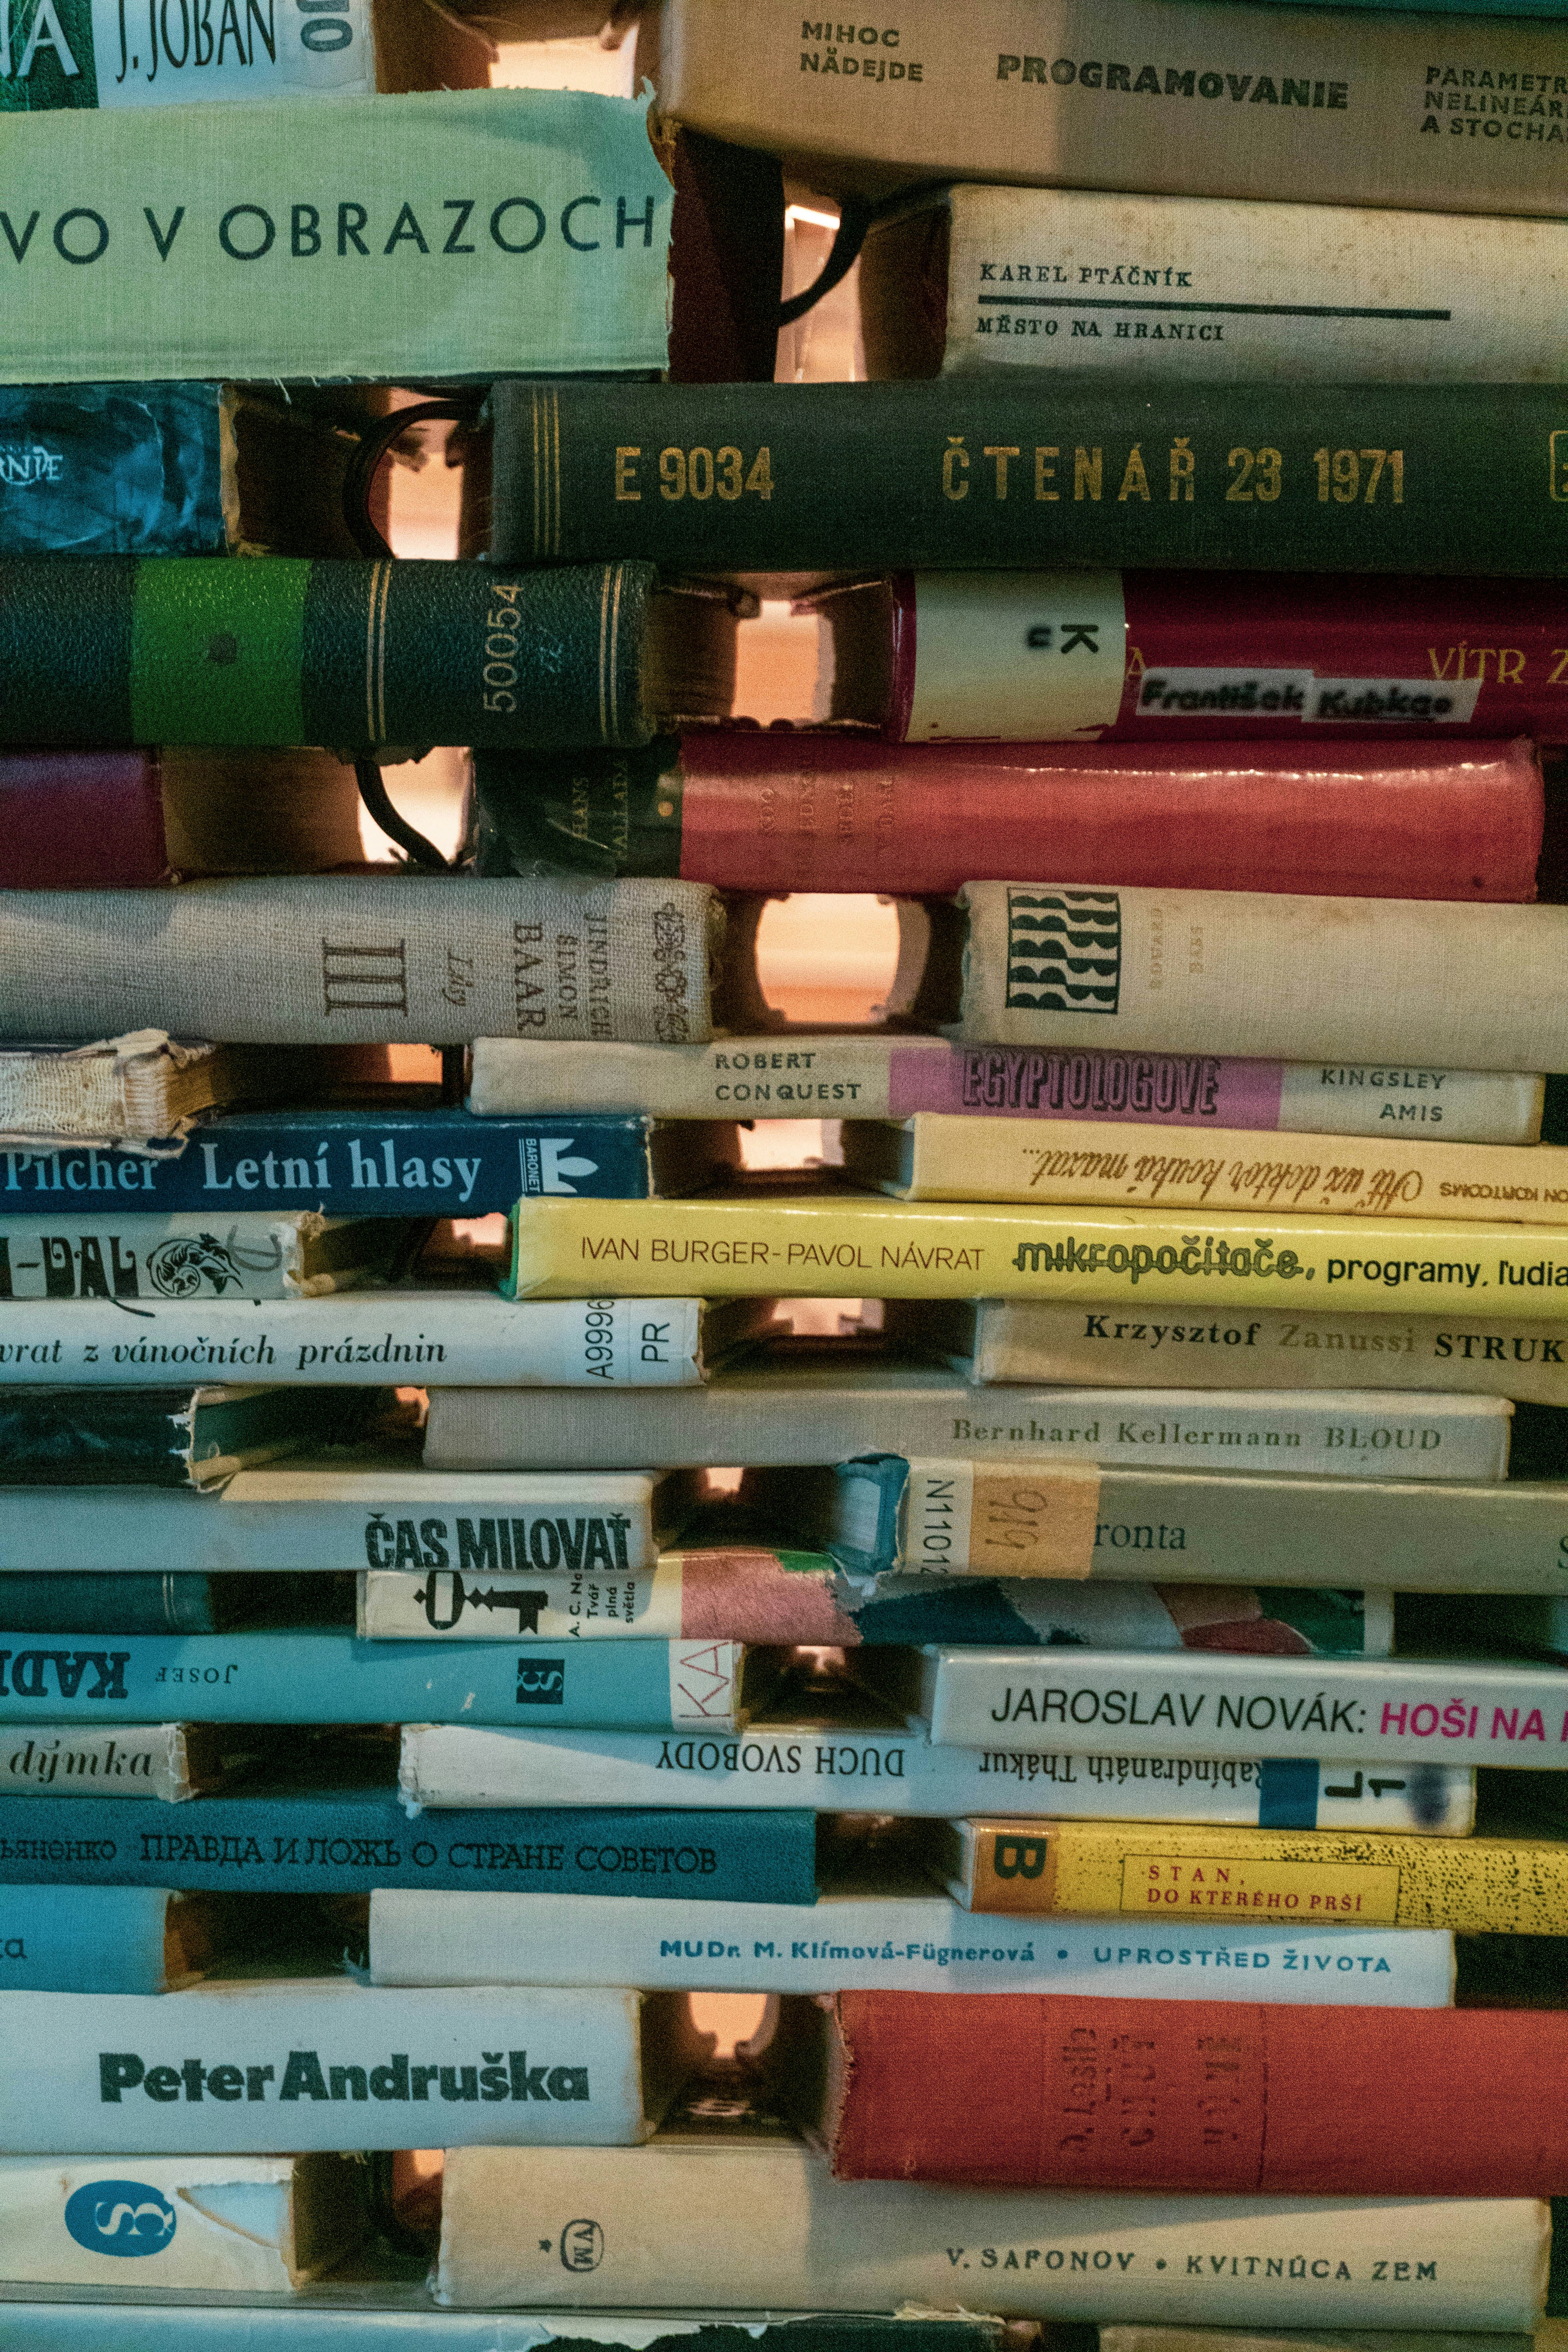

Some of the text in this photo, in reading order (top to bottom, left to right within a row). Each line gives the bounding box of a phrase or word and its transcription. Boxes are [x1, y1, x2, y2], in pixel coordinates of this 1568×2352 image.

[801, 20, 900, 47] MIHOC
[996, 54, 1348, 110] PROGRAMOVANIE
[1426, 66, 1568, 94] PARAMETR
[1424, 90, 1568, 118] NELINEÁR
[1420, 115, 1568, 143] A STOCHA
[0, 195, 655, 265] VO V OBRAZOCH
[979, 263, 1193, 289] KAREL PTÁČNÍK
[976, 315, 1225, 341] MĚSTO NA HRANICI
[615, 436, 1405, 504] E 9034 ČTENÁŘ 23 1971
[483, 584, 525, 713] 50054
[1060, 624, 1099, 654] K
[1428, 641, 1526, 684] VÍTR
[514, 922, 547, 1031] BAAR
[715, 1053, 816, 1069] ROBERT
[715, 1083, 861, 1100] CONQUEST
[1321, 1069, 1446, 1089] KINGSLEY
[1379, 1103, 1443, 1122] AMIS
[200, 1142, 332, 1189] Letní
[349, 1139, 481, 1202] hlasy
[527, 1138, 540, 1193] BARONET
[1127, 1154, 1225, 1201] kouká
[1229, 1159, 1321, 1204] doktor
[1439, 1181, 1538, 1201] KORTOOMS
[582, 1236, 639, 1261] IVAN
[880, 1242, 984, 1270] NÁVRAT
[1327, 1256, 1488, 1288] programy,
[83, 1344, 99, 1363] z
[112, 1335, 276, 1364] vánočních
[296, 1333, 447, 1370] prázdnin
[641, 1323, 670, 1362] PR
[1083, 1314, 1565, 1363] Krzysztof Zanussi STRUK
[953, 1419, 1441, 1450] Bernhard Kellermann BLOUD
[365, 1513, 448, 1569] ČAS
[569, 1601, 581, 1616] C.
[586, 1584, 599, 1619] Tvář
[605, 1587, 619, 1618] plná
[623, 1582, 635, 1623] světla
[156, 1665, 238, 1684] JOSEF
[991, 1687, 1205, 1728] JAROSLAV
[1217, 1693, 1366, 1733] NOVÁK:
[1379, 1698, 1478, 1738] HOŠI
[1490, 1708, 1546, 1742] NA
[656, 1741, 905, 1776] DUCH SVOBODY
[979, 1752, 1076, 1783] Thákur
[140, 1833, 265, 1868] ПРАВДА
[272, 1837, 299, 1864] И
[305, 1837, 401, 1867] ЛОЖЬ
[412, 1841, 437, 1867] О
[448, 1842, 564, 1871] СТРАНЕ
[575, 1846, 717, 1874] СОВЕТОВ
[993, 1835, 1048, 1880] B
[1148, 1864, 1245, 1886] STAN,
[1147, 1887, 1362, 1912] DO KTERÉHO PRŠÍ
[753, 1941, 782, 1959] M.
[791, 1940, 1035, 1965] Klímová-Fügnerová
[1093, 1946, 1270, 1969] UPROSTŘED
[1283, 1948, 1390, 1973] ŽIVOTA
[99, 2050, 590, 2102] Peter Andruška
[947, 2248, 969, 2269] V.
[1371, 2261, 1437, 2281] ZEM
